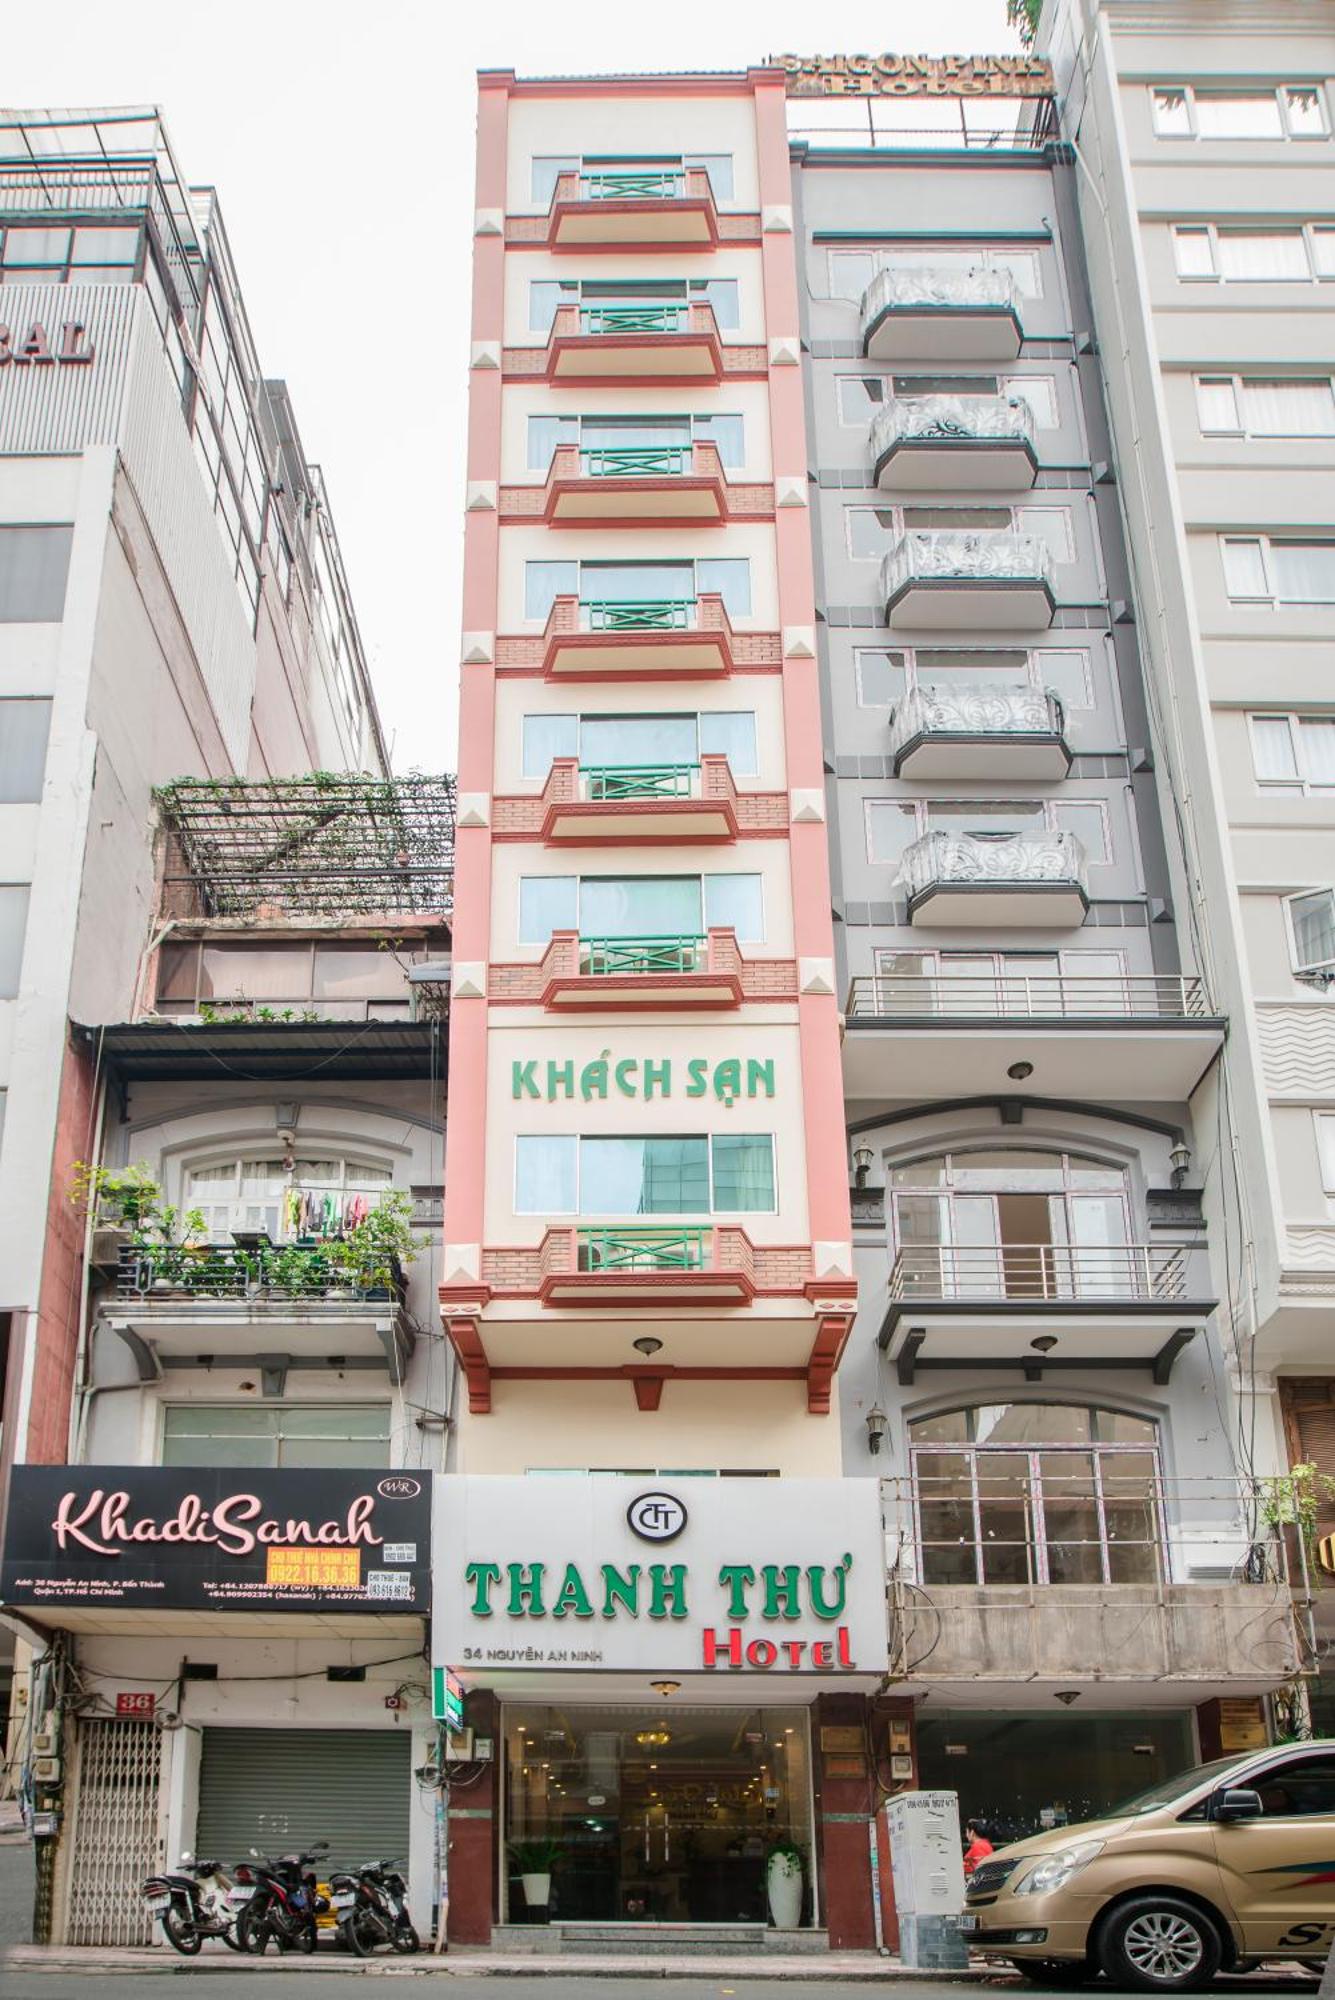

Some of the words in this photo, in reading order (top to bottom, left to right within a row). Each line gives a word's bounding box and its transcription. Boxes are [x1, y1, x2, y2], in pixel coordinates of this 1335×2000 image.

[942, 54, 1045, 76] PINK
[511, 1049, 672, 1102] KHÁCH
[686, 1058, 776, 1108] SẠN
[464, 1562, 690, 1619] THANH
[718, 1552, 853, 1619] THƯ
[463, 1648, 483, 1660] 34
[487, 1646, 544, 1661] NGUYỄN
[547, 1650, 568, 1661] AN
[571, 1650, 603, 1663] NINH
[121, 1695, 151, 1709] 36
